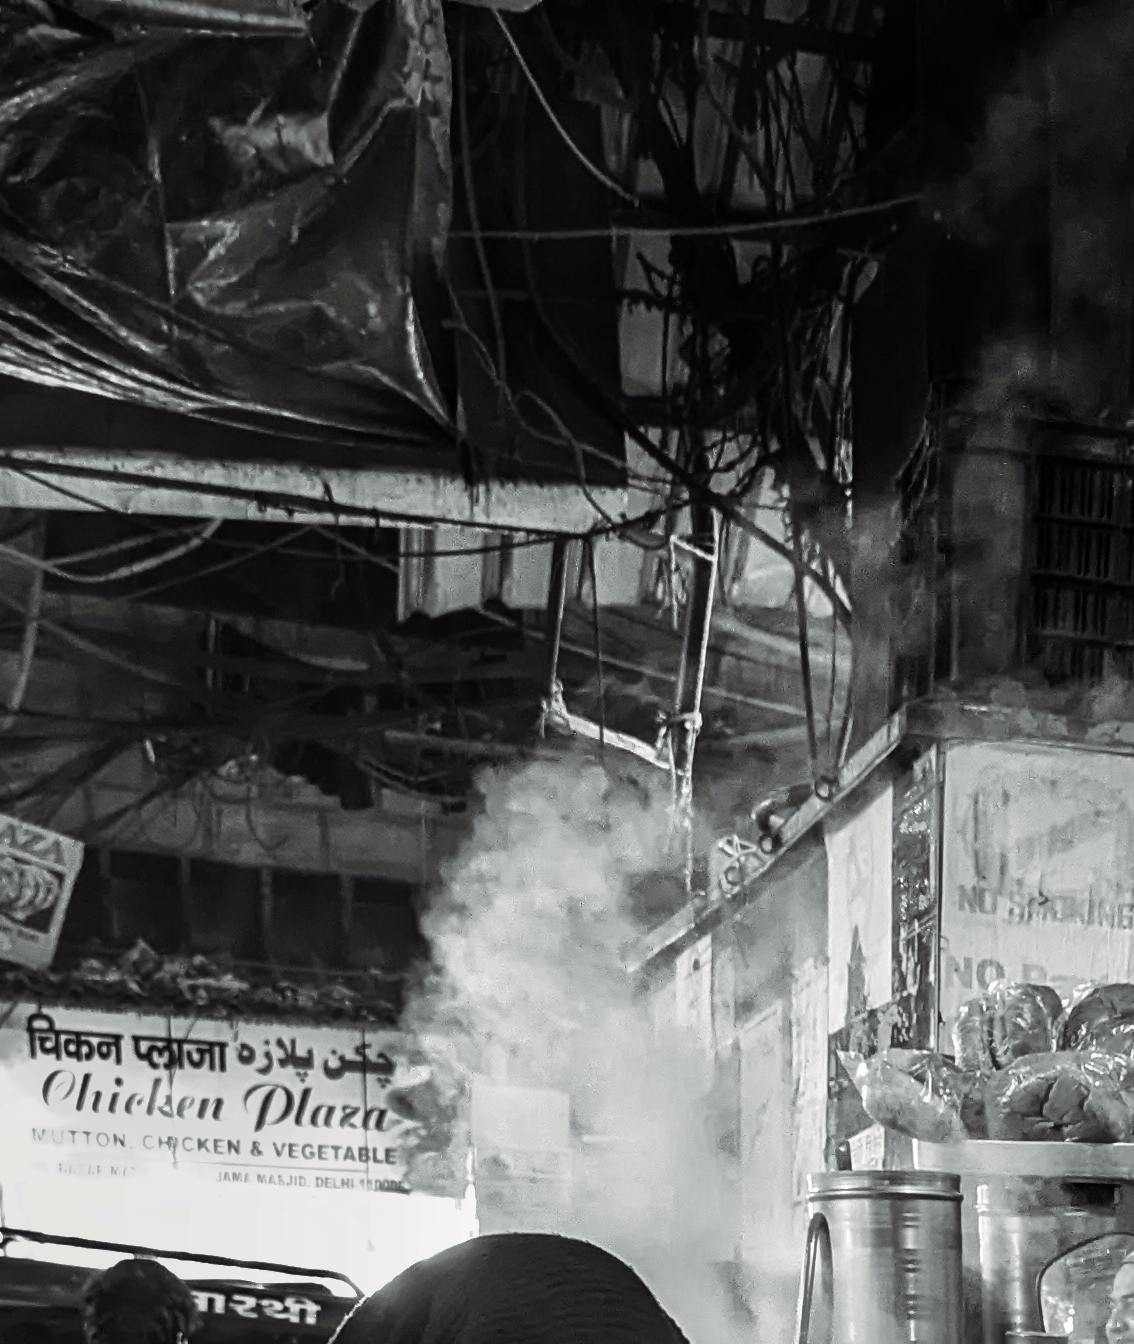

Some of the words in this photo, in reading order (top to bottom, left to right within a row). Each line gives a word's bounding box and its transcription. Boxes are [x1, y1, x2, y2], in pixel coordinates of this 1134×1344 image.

[26, 1013, 124, 1066] चिकन
[131, 1034, 229, 1073] प्लाजा
[42, 1069, 226, 1122] Chicken
[243, 1083, 390, 1133] Plaza
[142, 1134, 241, 1156] CHICKEN
[250, 1140, 264, 1157] &
[272, 1141, 398, 1165] VEGETABLE
[315, 1176, 355, 1190] DELHI
